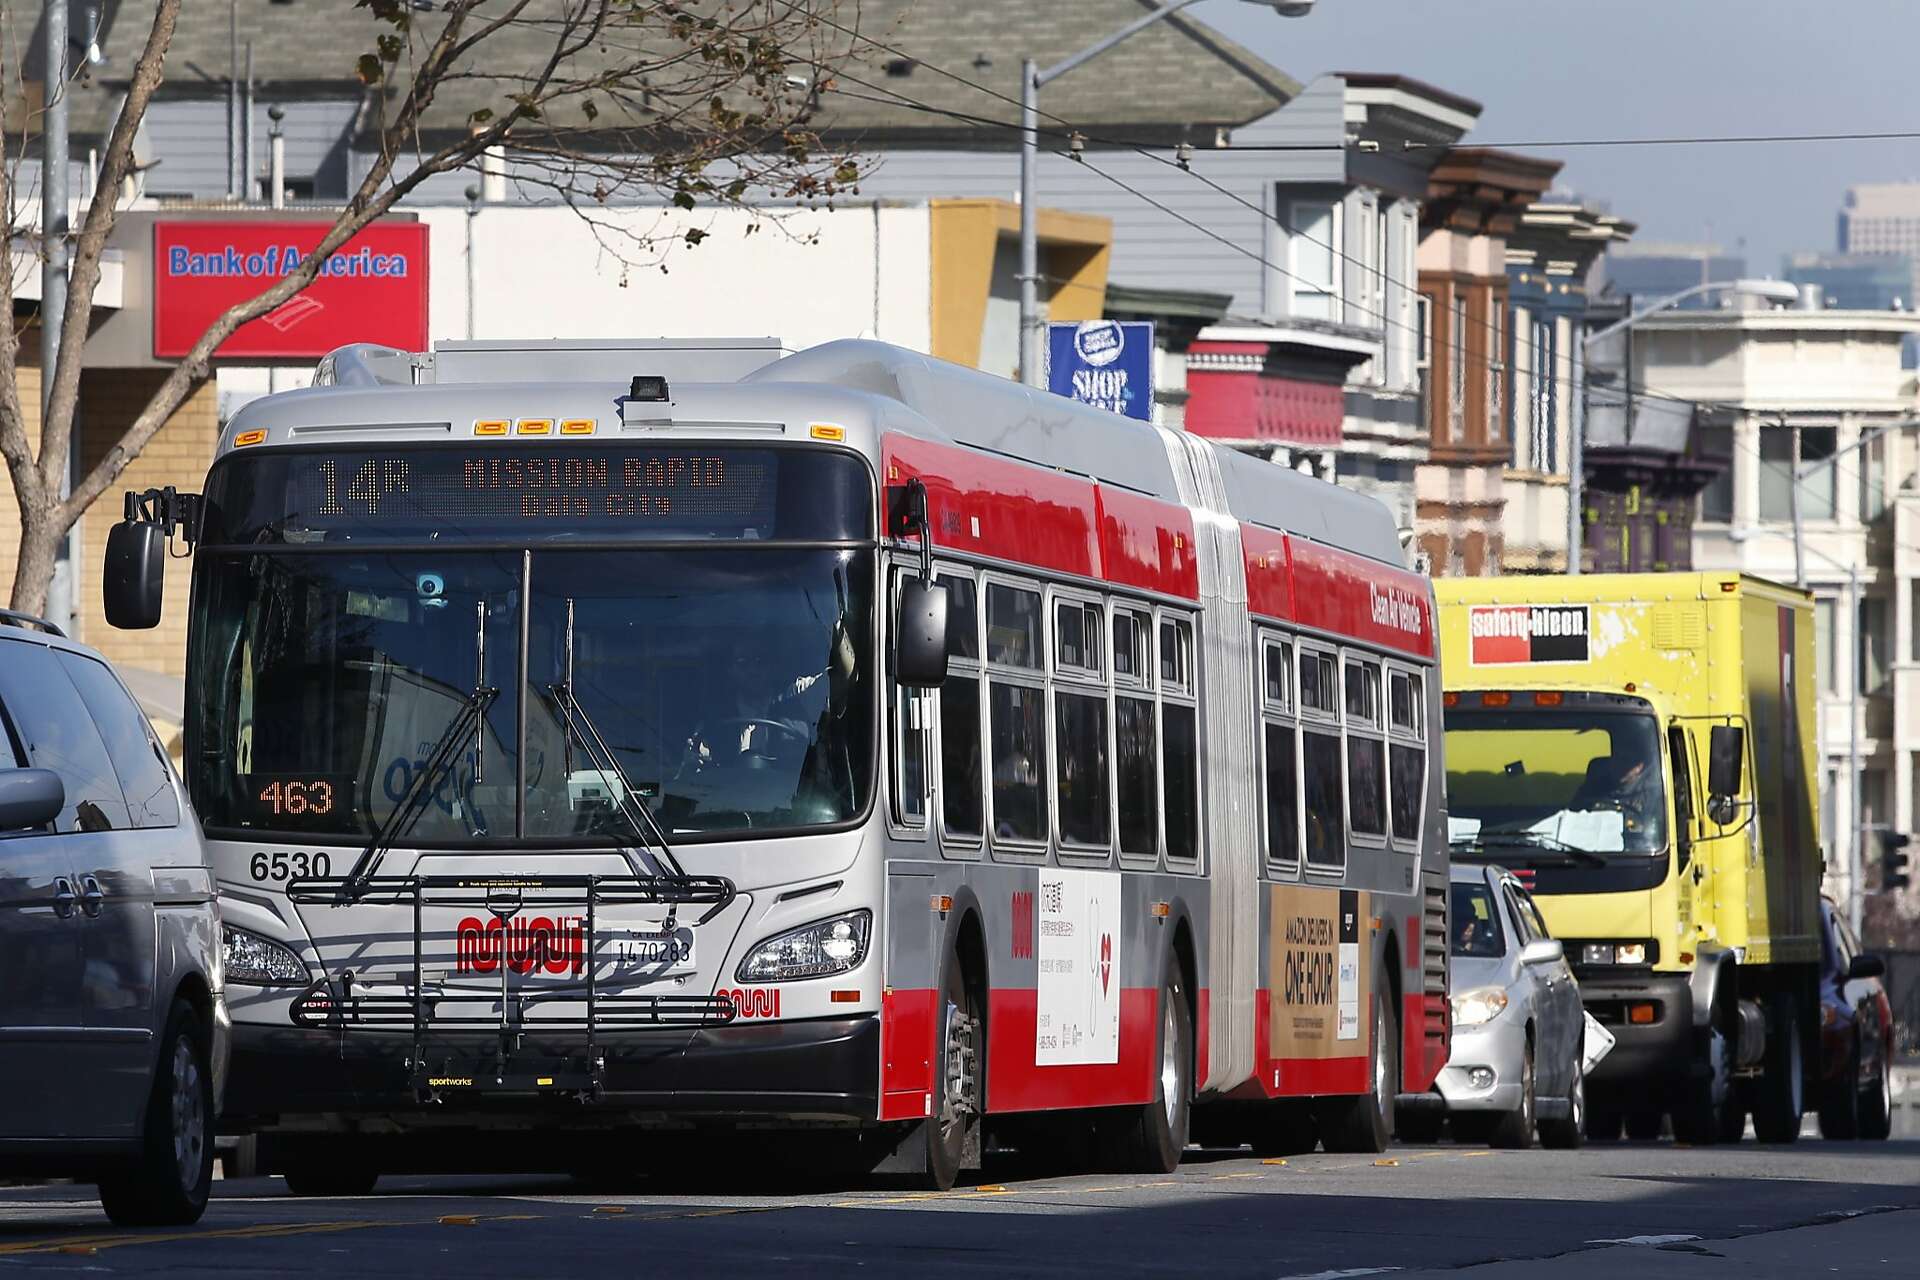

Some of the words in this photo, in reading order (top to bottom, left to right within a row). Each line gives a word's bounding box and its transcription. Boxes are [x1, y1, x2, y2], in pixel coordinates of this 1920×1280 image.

[168, 245, 244, 276] Bank
[247, 246, 278, 277] of
[1072, 368, 1128, 401] SHOP
[464, 458, 608, 488] MISSION
[624, 457, 724, 487] RAPID
[521, 494, 588, 516] Daly
[606, 494, 671, 516] City
[260, 781, 332, 814] 463
[250, 852, 331, 881] 6530
[1286, 916, 1306, 945] AMAZON
[617, 941, 690, 962] 1470283
[1285, 950, 1304, 1005] ONE
[1306, 952, 1333, 1006] HOUR
[428, 1076, 473, 1087] sportworks
